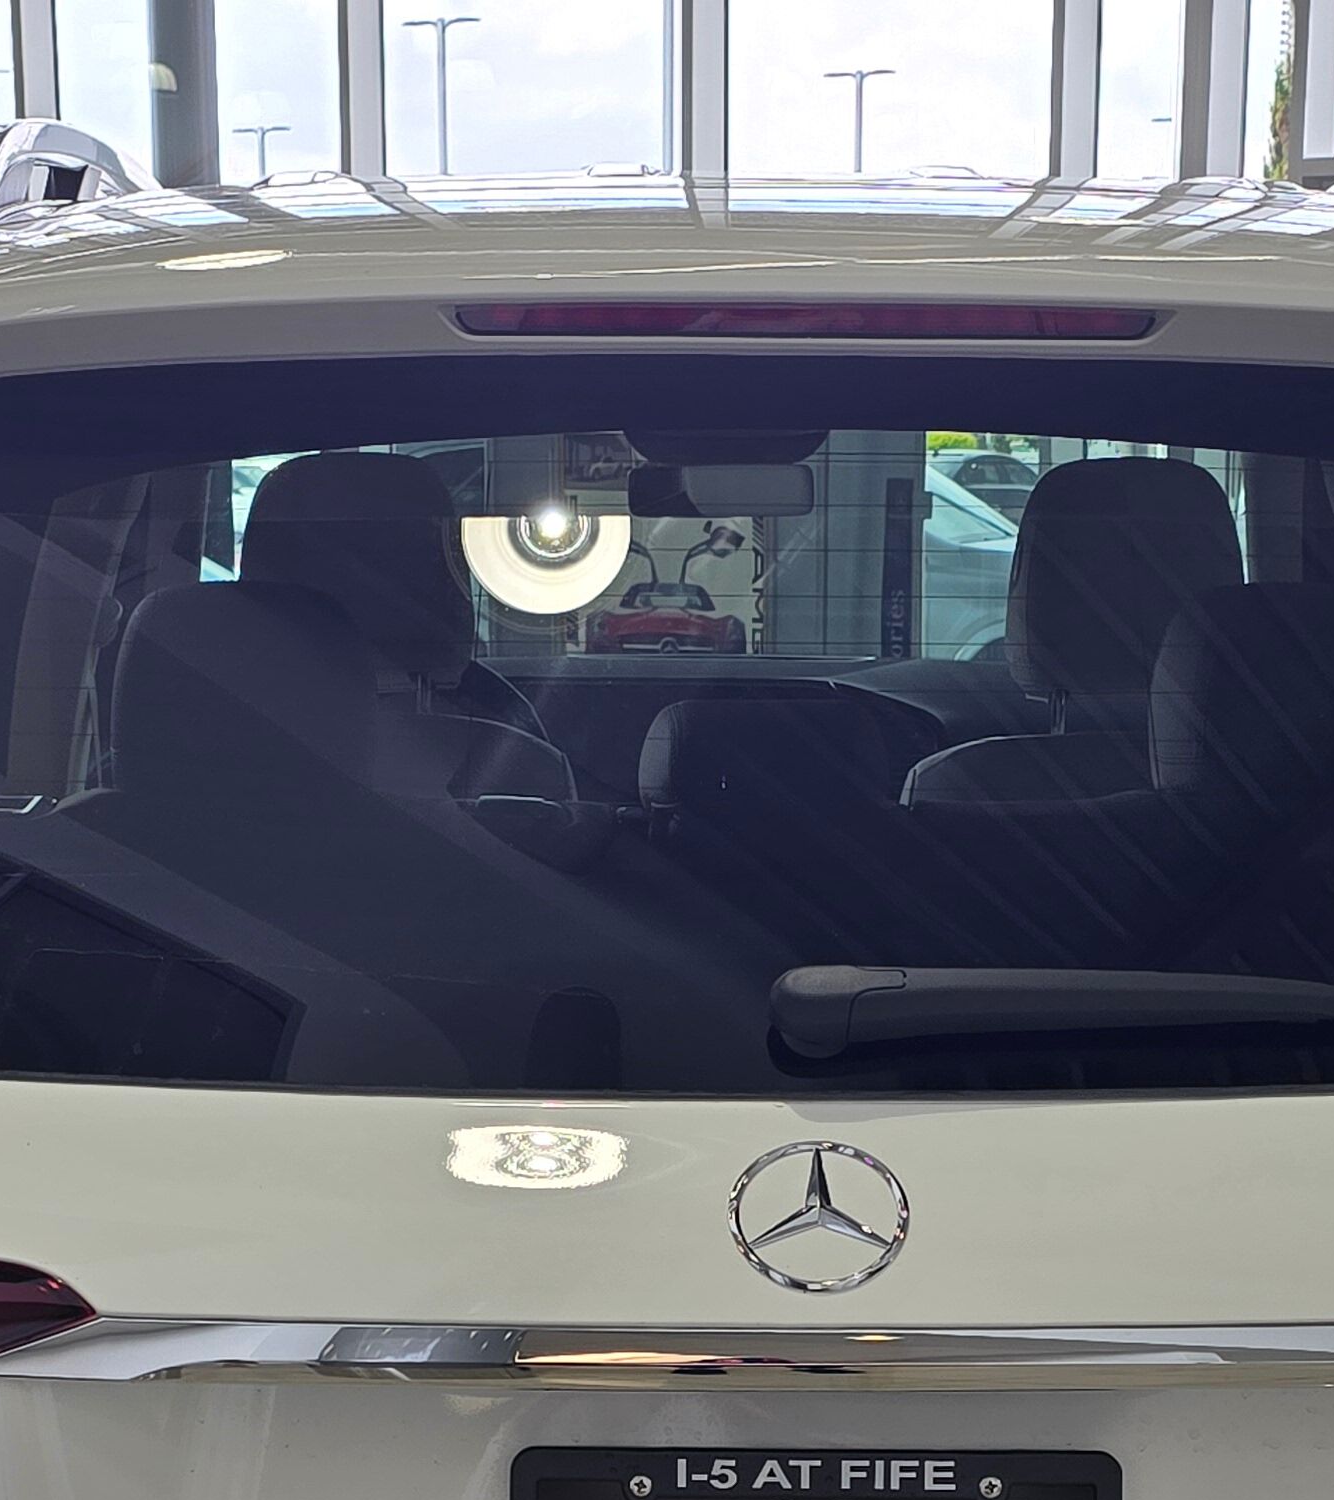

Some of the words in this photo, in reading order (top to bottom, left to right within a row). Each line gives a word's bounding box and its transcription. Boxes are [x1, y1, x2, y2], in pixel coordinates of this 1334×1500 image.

[676, 1458, 739, 1489] I-5
[752, 1460, 822, 1490] AT
[841, 1460, 958, 1491] FIFE
